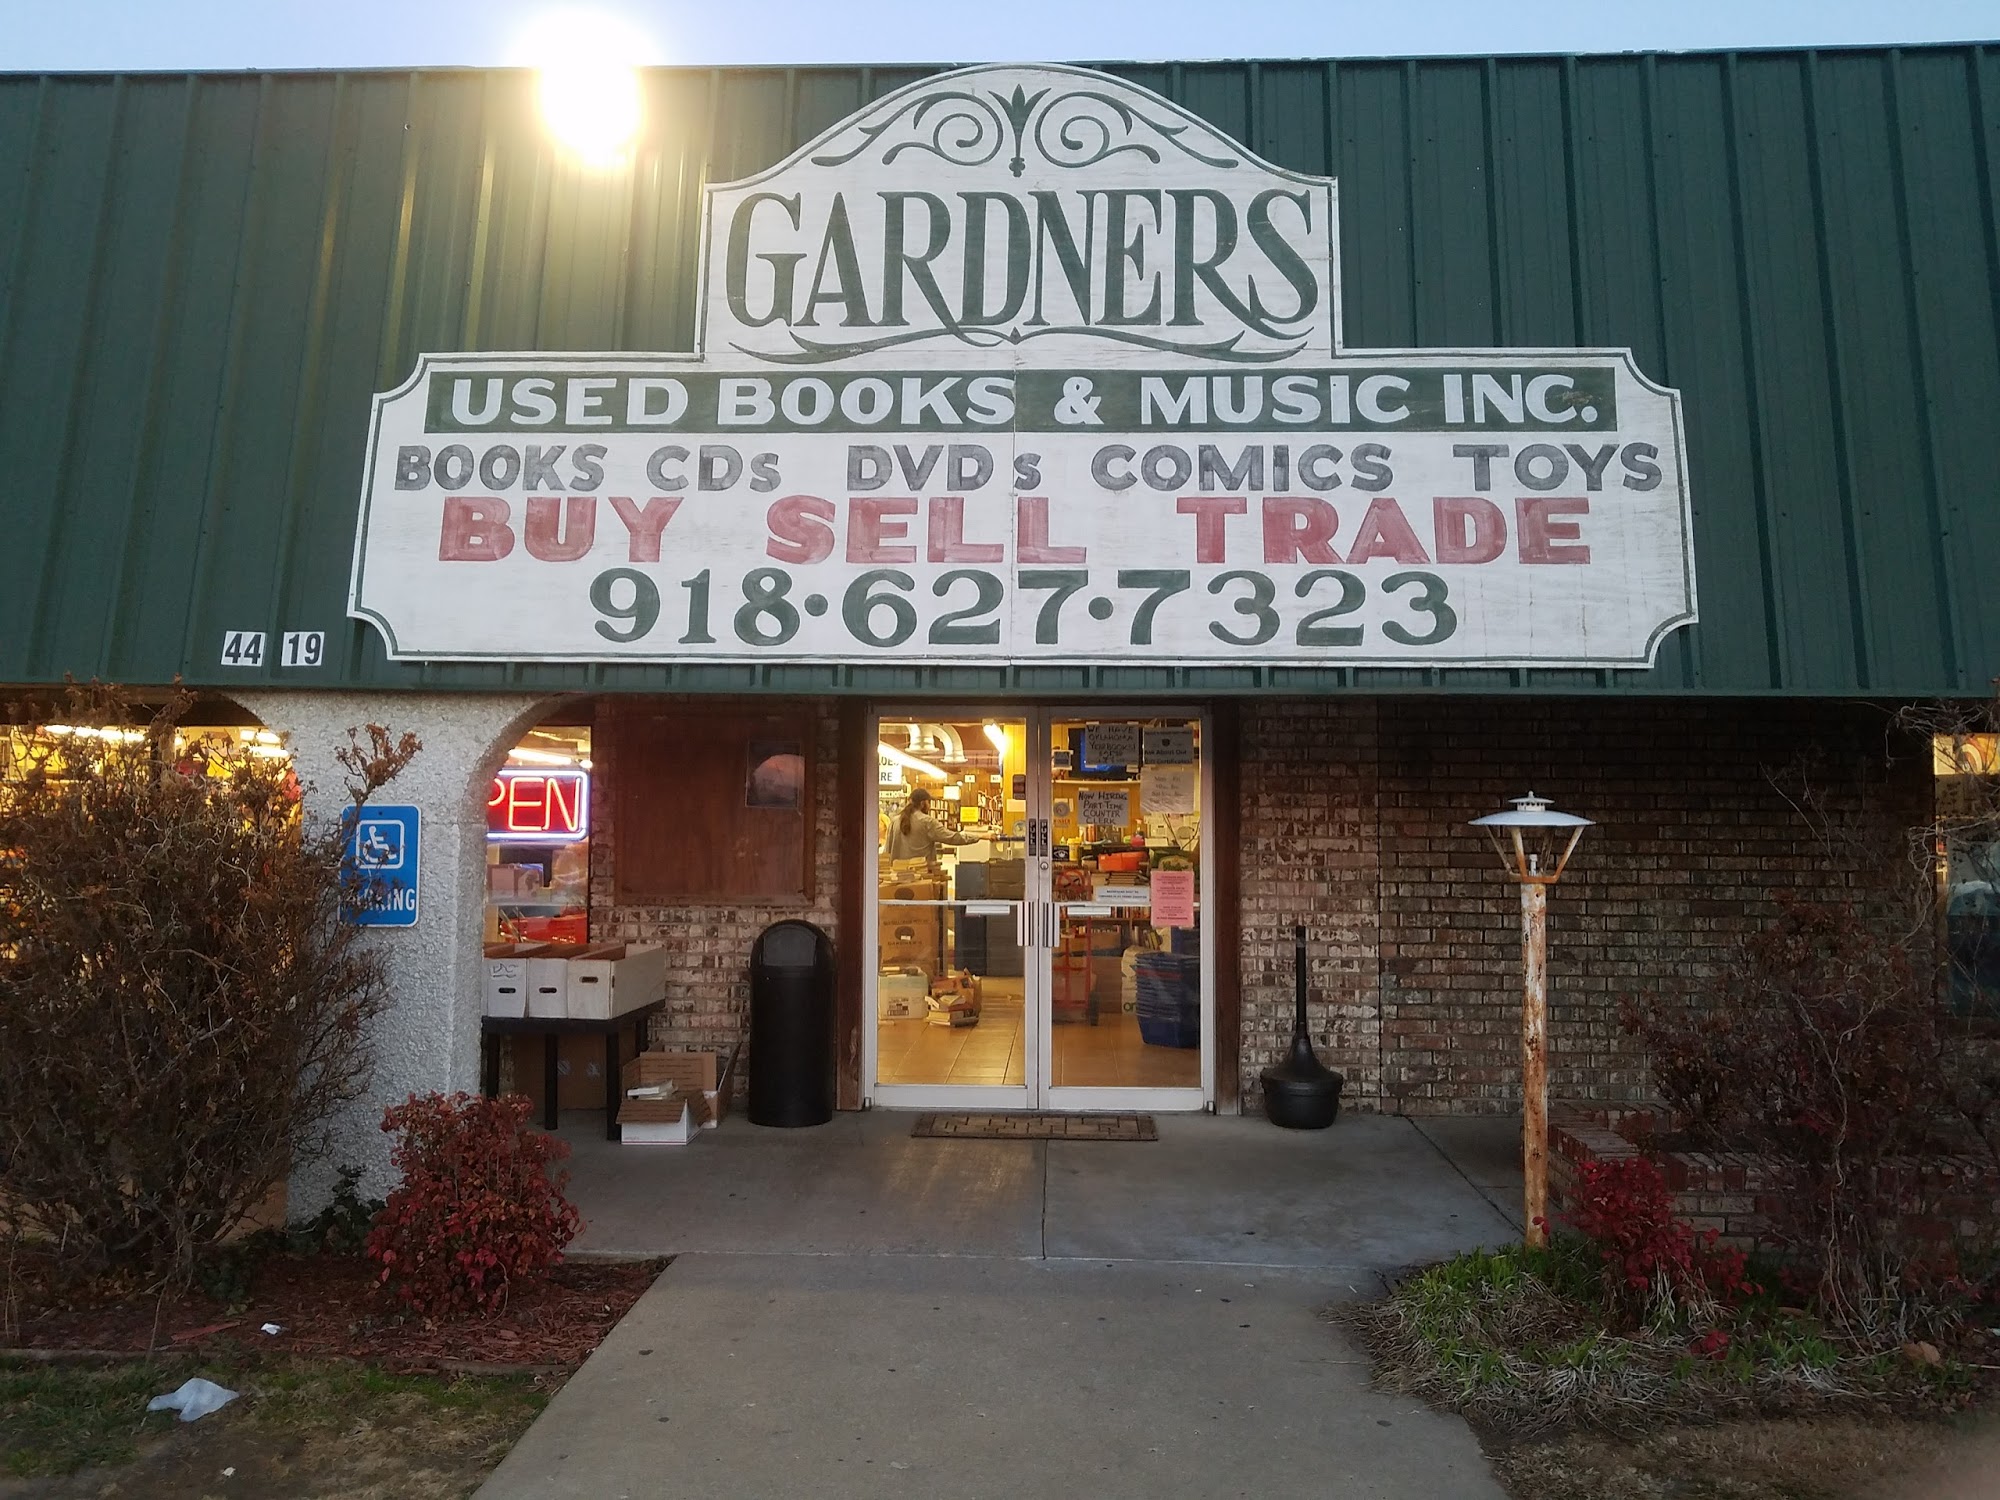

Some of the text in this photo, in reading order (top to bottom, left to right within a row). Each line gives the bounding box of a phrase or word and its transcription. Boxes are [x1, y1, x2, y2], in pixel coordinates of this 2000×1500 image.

[725, 188, 1320, 334] GARDNERS
[452, 373, 1598, 425] USED BOOKS & MUSIC INC.
[395, 444, 608, 491] BOOKS
[646, 444, 781, 491] CDs
[1091, 443, 1393, 491] COMICS
[1453, 442, 1663, 491] TOYS
[438, 494, 1591, 565] BUY SELL TRADE
[1078, 791, 1128, 800] NOW HIRING
[1083, 800, 1102, 809] PART
[1083, 809, 1121, 818] COUNTER
